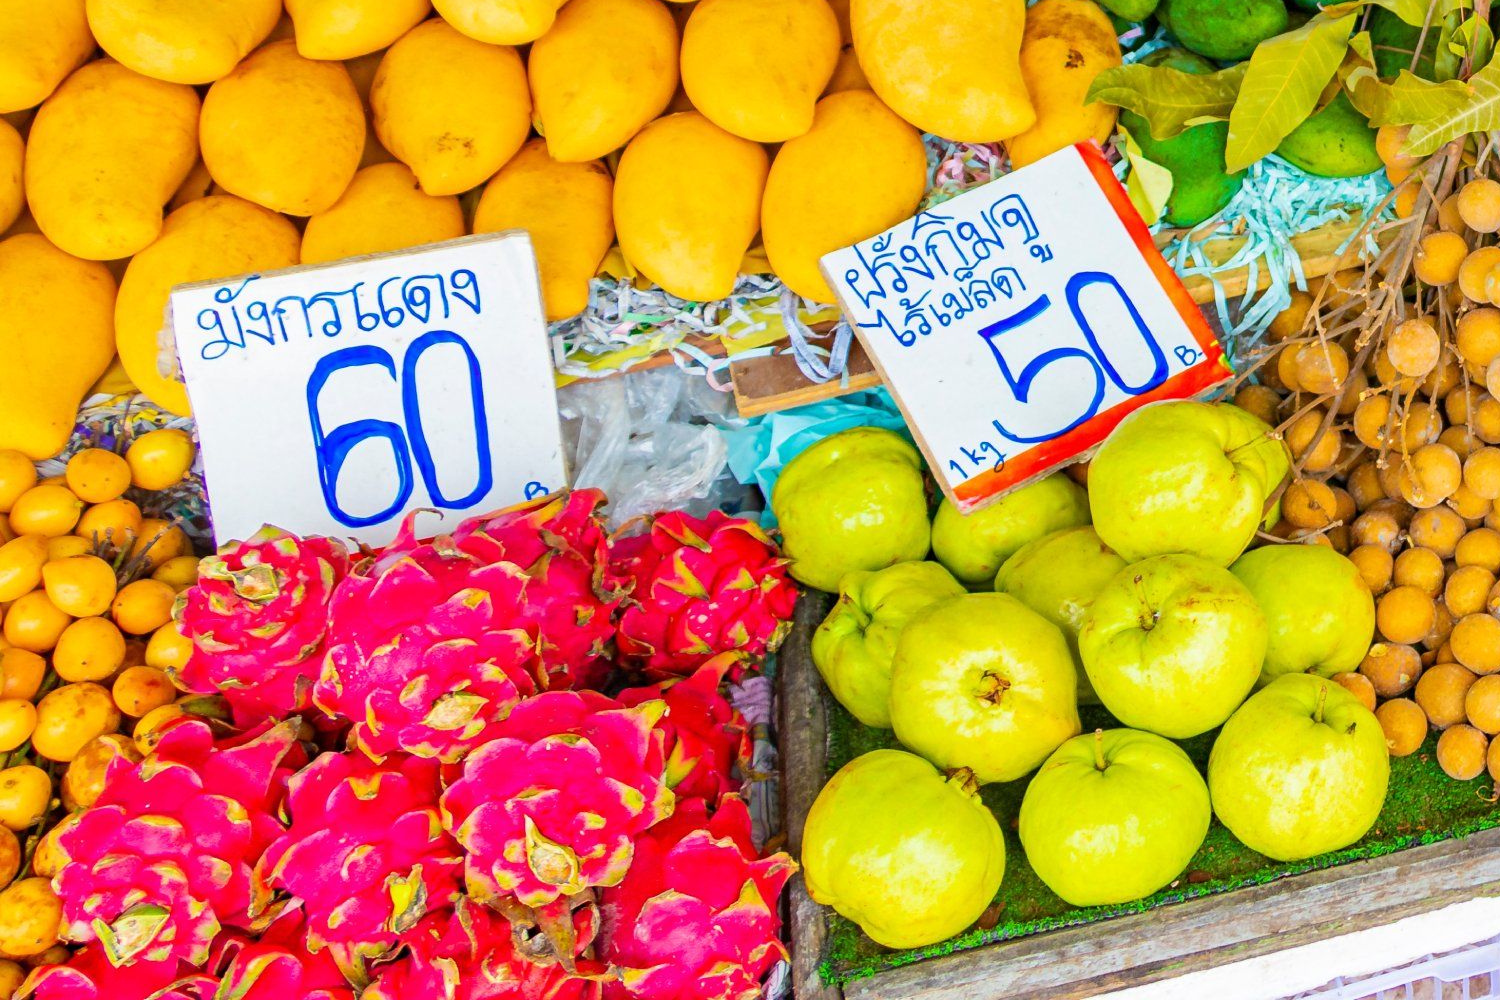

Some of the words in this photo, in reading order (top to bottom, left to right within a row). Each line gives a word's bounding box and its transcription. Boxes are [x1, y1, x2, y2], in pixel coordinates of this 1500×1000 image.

[196, 268, 482, 361] มังกรแดง
[856, 258, 1027, 348] ไร้เมล็ด
[978, 271, 1170, 444] 50
[306, 329, 493, 529] 60
